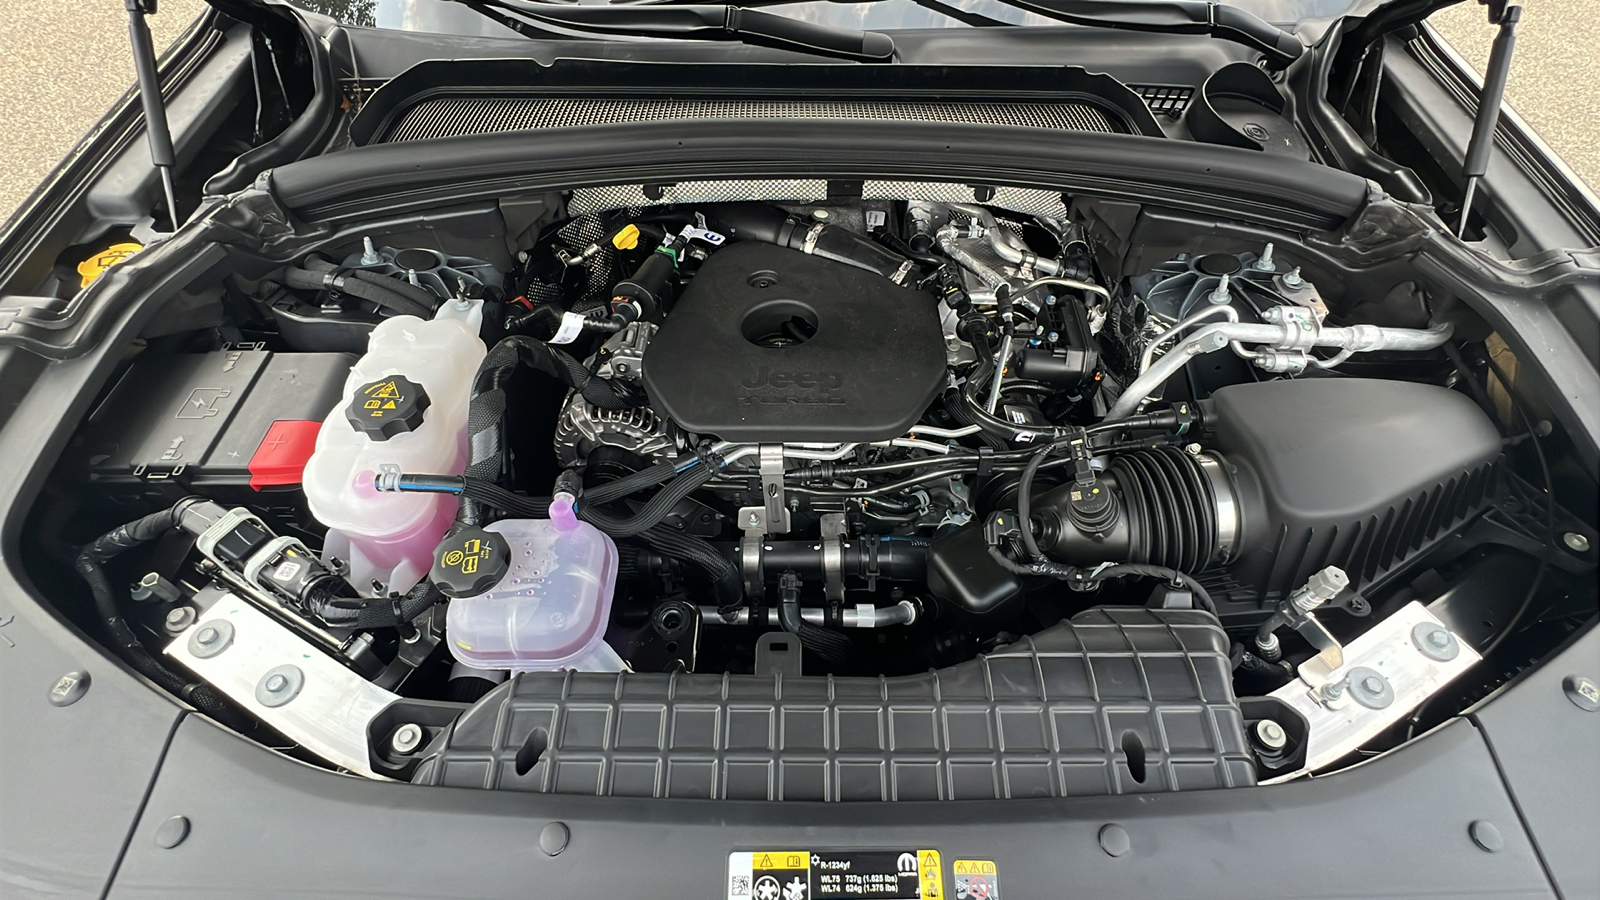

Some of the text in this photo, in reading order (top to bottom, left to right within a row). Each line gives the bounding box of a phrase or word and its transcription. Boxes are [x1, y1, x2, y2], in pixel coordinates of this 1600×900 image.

[741, 365, 844, 391] Jeep
[820, 861, 851, 870] R-1234yf
[820, 874, 841, 883] WL75
[845, 874, 862, 884] 737g
[885, 874, 898, 883] lbs)
[820, 884, 898, 893] WL74 624g (1.375 lbs)
